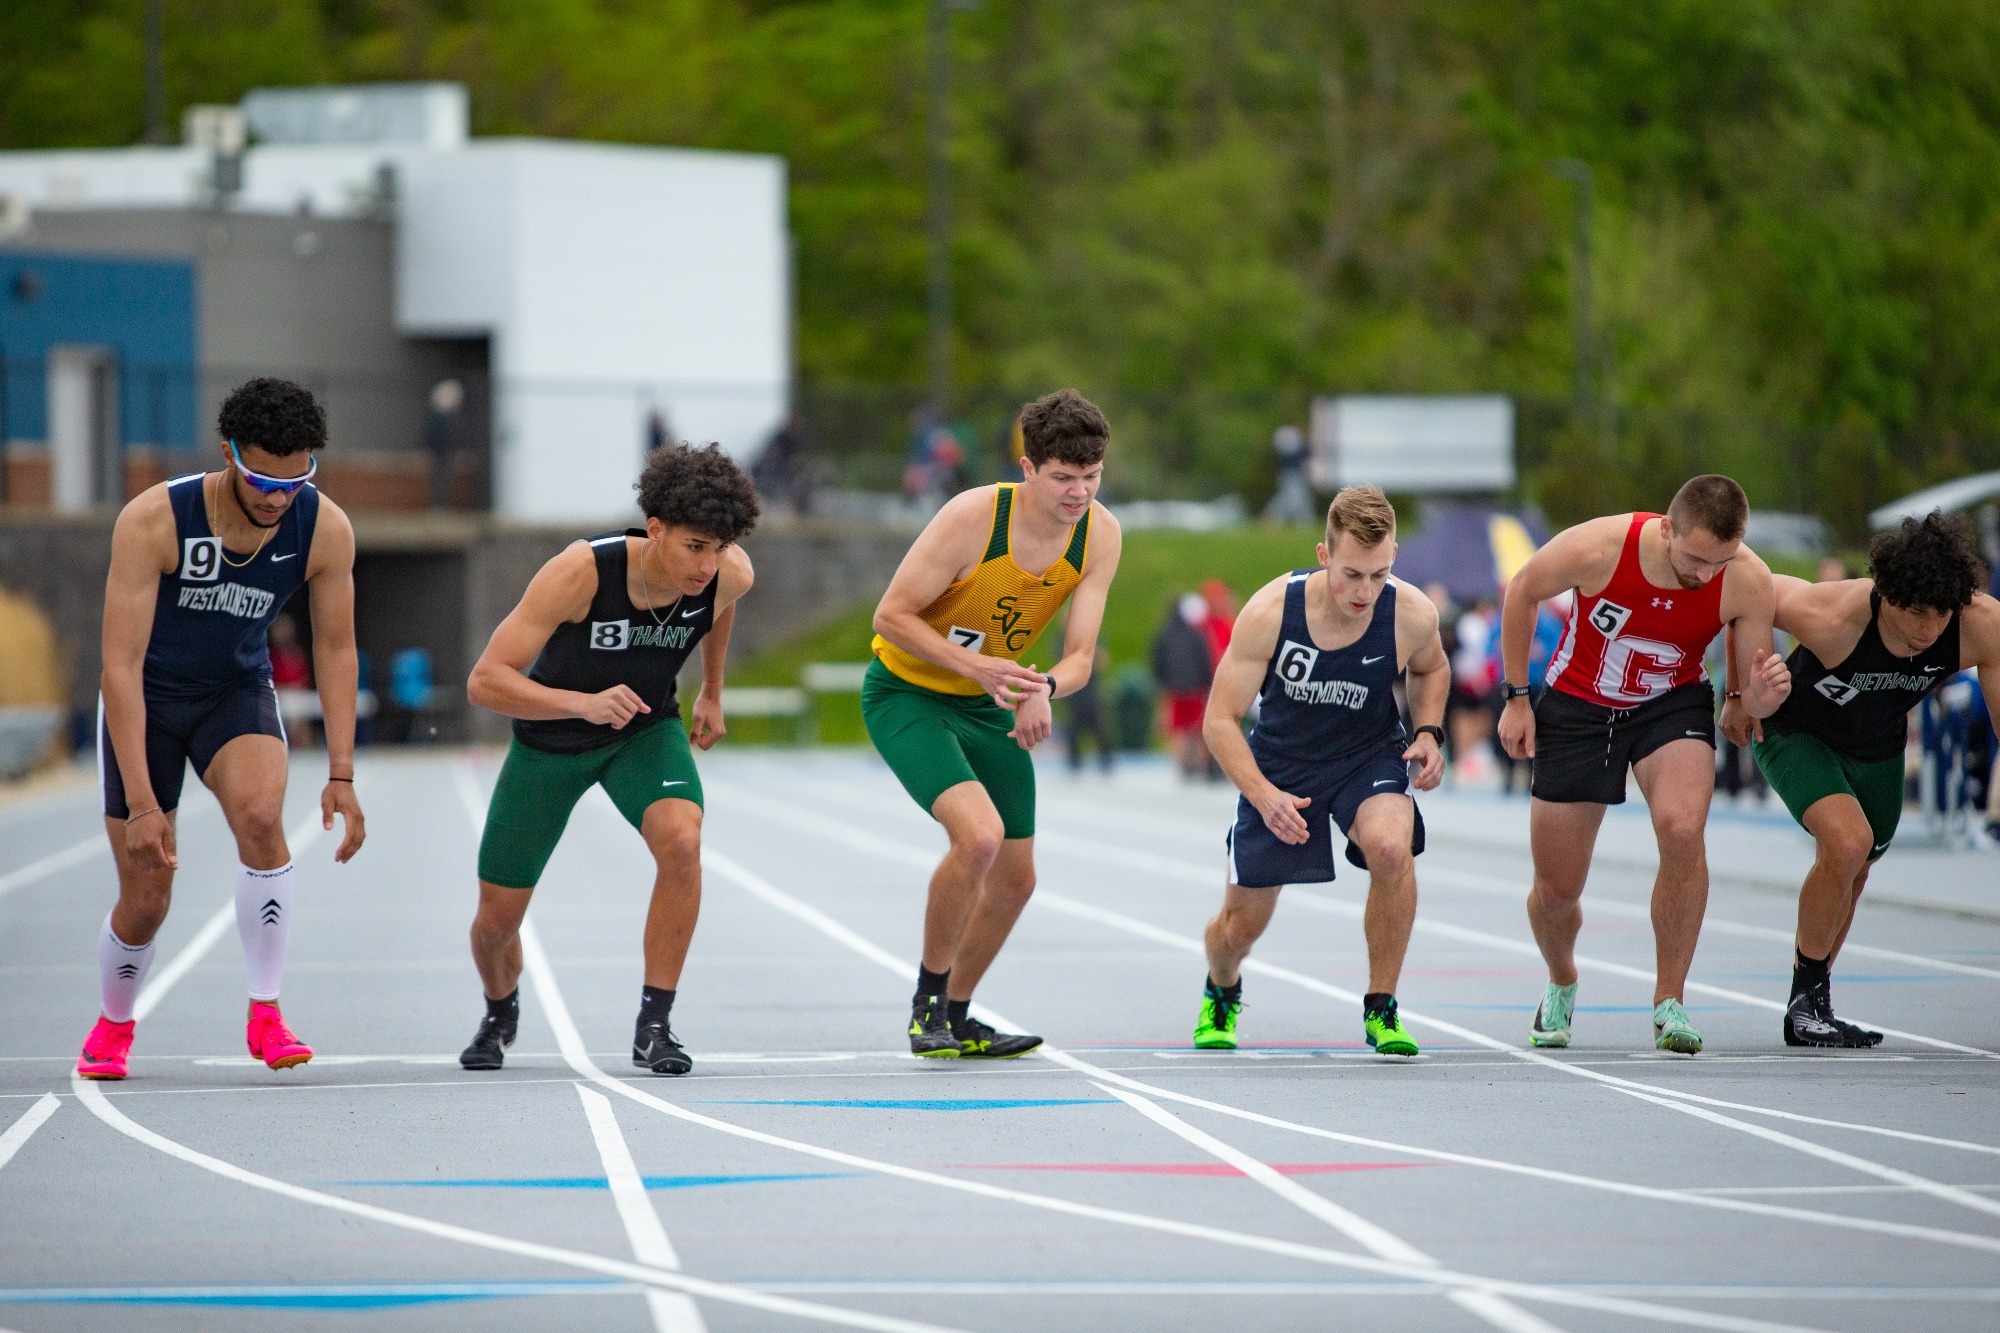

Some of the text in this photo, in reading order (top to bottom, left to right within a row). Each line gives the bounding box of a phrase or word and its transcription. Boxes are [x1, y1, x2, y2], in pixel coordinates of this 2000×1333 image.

[189, 541, 216, 578] 9
[177, 582, 275, 618] WESTMINSTER
[1592, 602, 1624, 633] 5
[595, 624, 622, 648] 8
[627, 626, 694, 648] THANY
[954, 629, 979, 648] 7
[1281, 647, 1311, 682] 6
[1593, 634, 1686, 702] G
[1284, 681, 1369, 710] WESTMINSTER
[1822, 683, 1852, 700] 4
[1848, 672, 1935, 692] BETHANY
